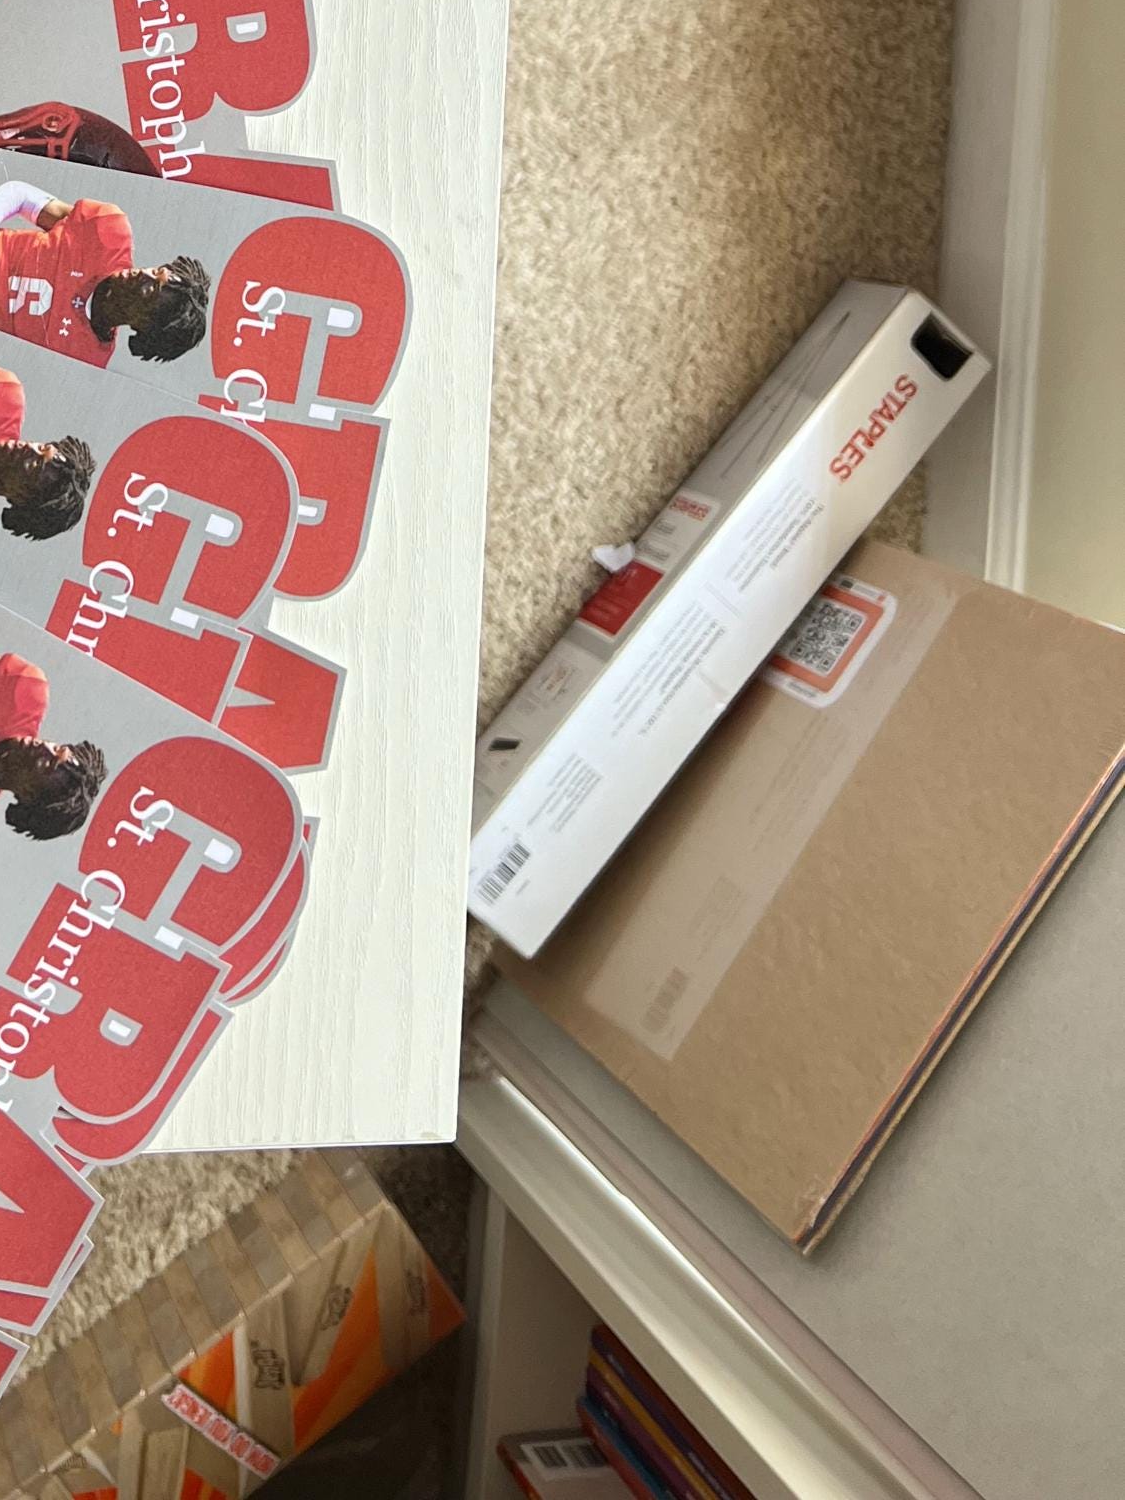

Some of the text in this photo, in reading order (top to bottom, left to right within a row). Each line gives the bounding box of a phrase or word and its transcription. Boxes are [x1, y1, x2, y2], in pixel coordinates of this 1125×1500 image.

[231, 280, 287, 347] St.
[828, 373, 918, 484] STAPLES
[106, 472, 169, 539] St.
[106, 785, 175, 849] St.
